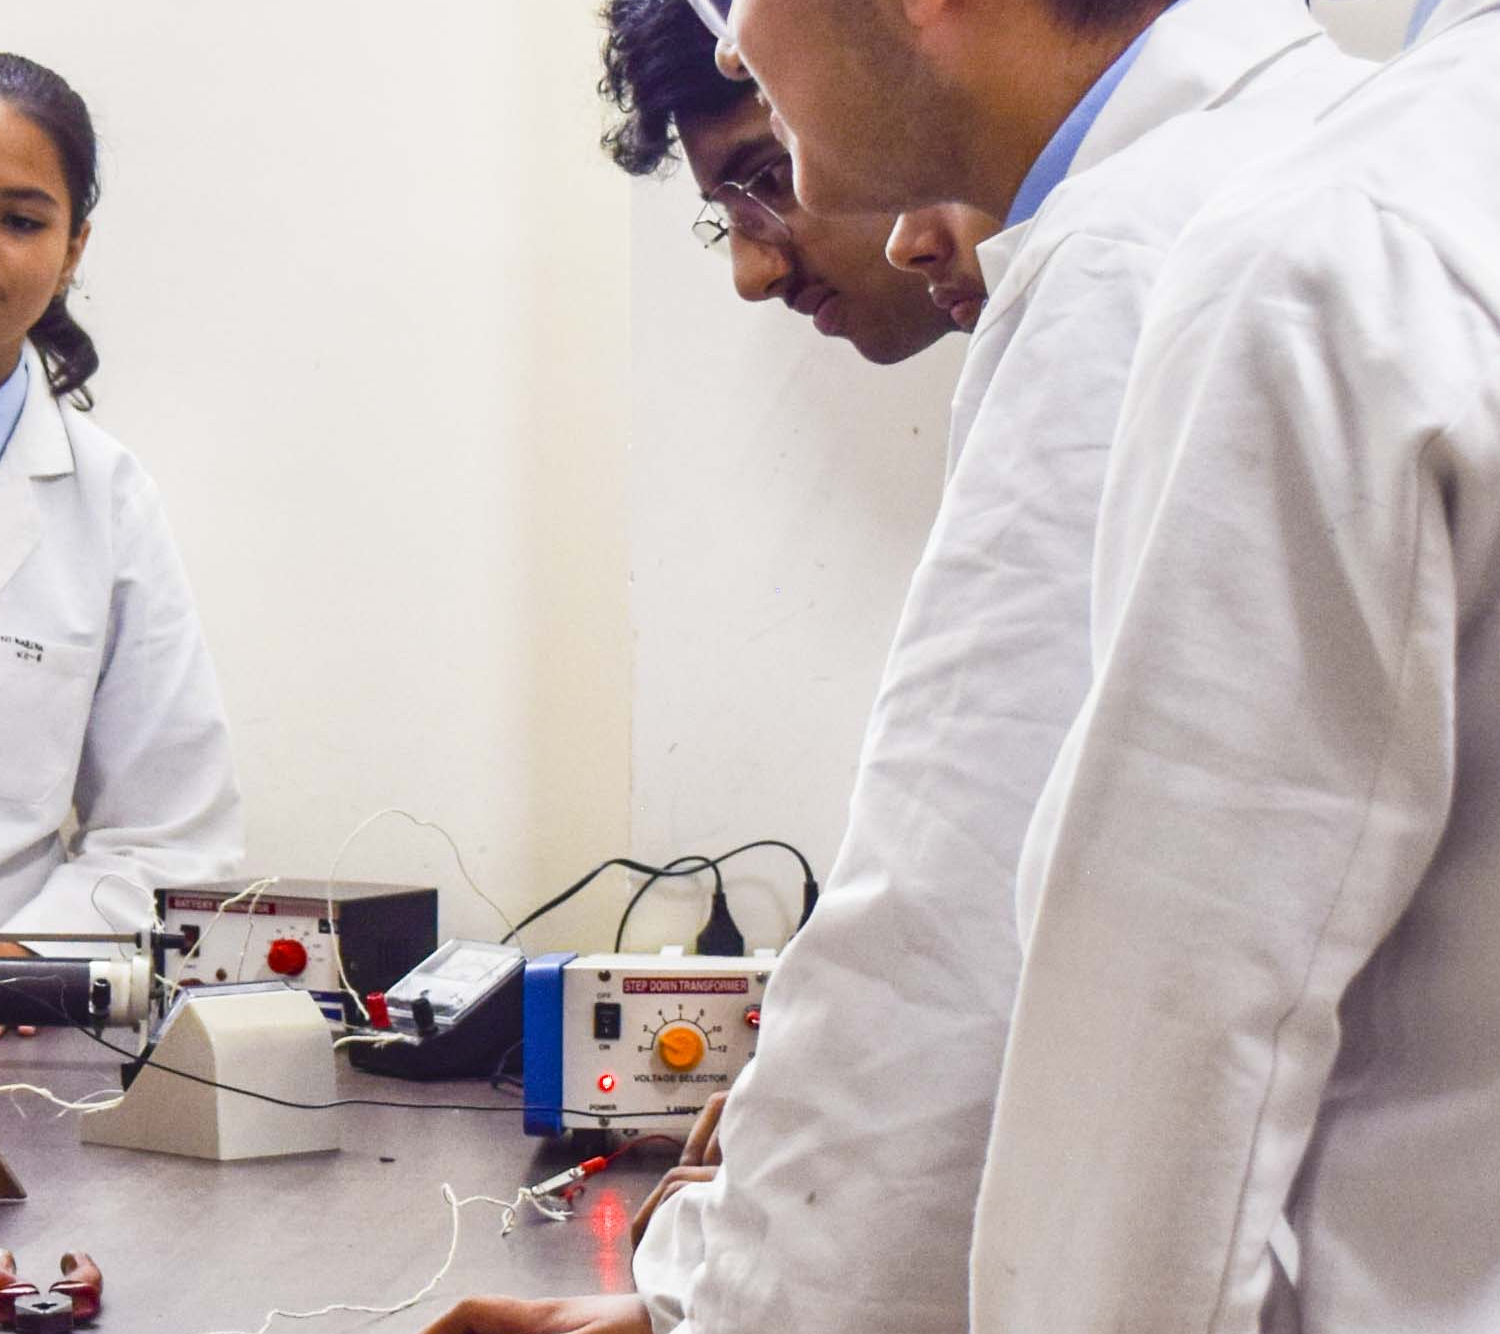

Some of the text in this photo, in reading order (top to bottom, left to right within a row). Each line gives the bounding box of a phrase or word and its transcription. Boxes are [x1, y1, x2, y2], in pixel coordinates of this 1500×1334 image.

[624, 979, 748, 992] STEP DOWN TRANSFORMER
[634, 1074, 728, 1082] VOLTAGE SELECTOR
